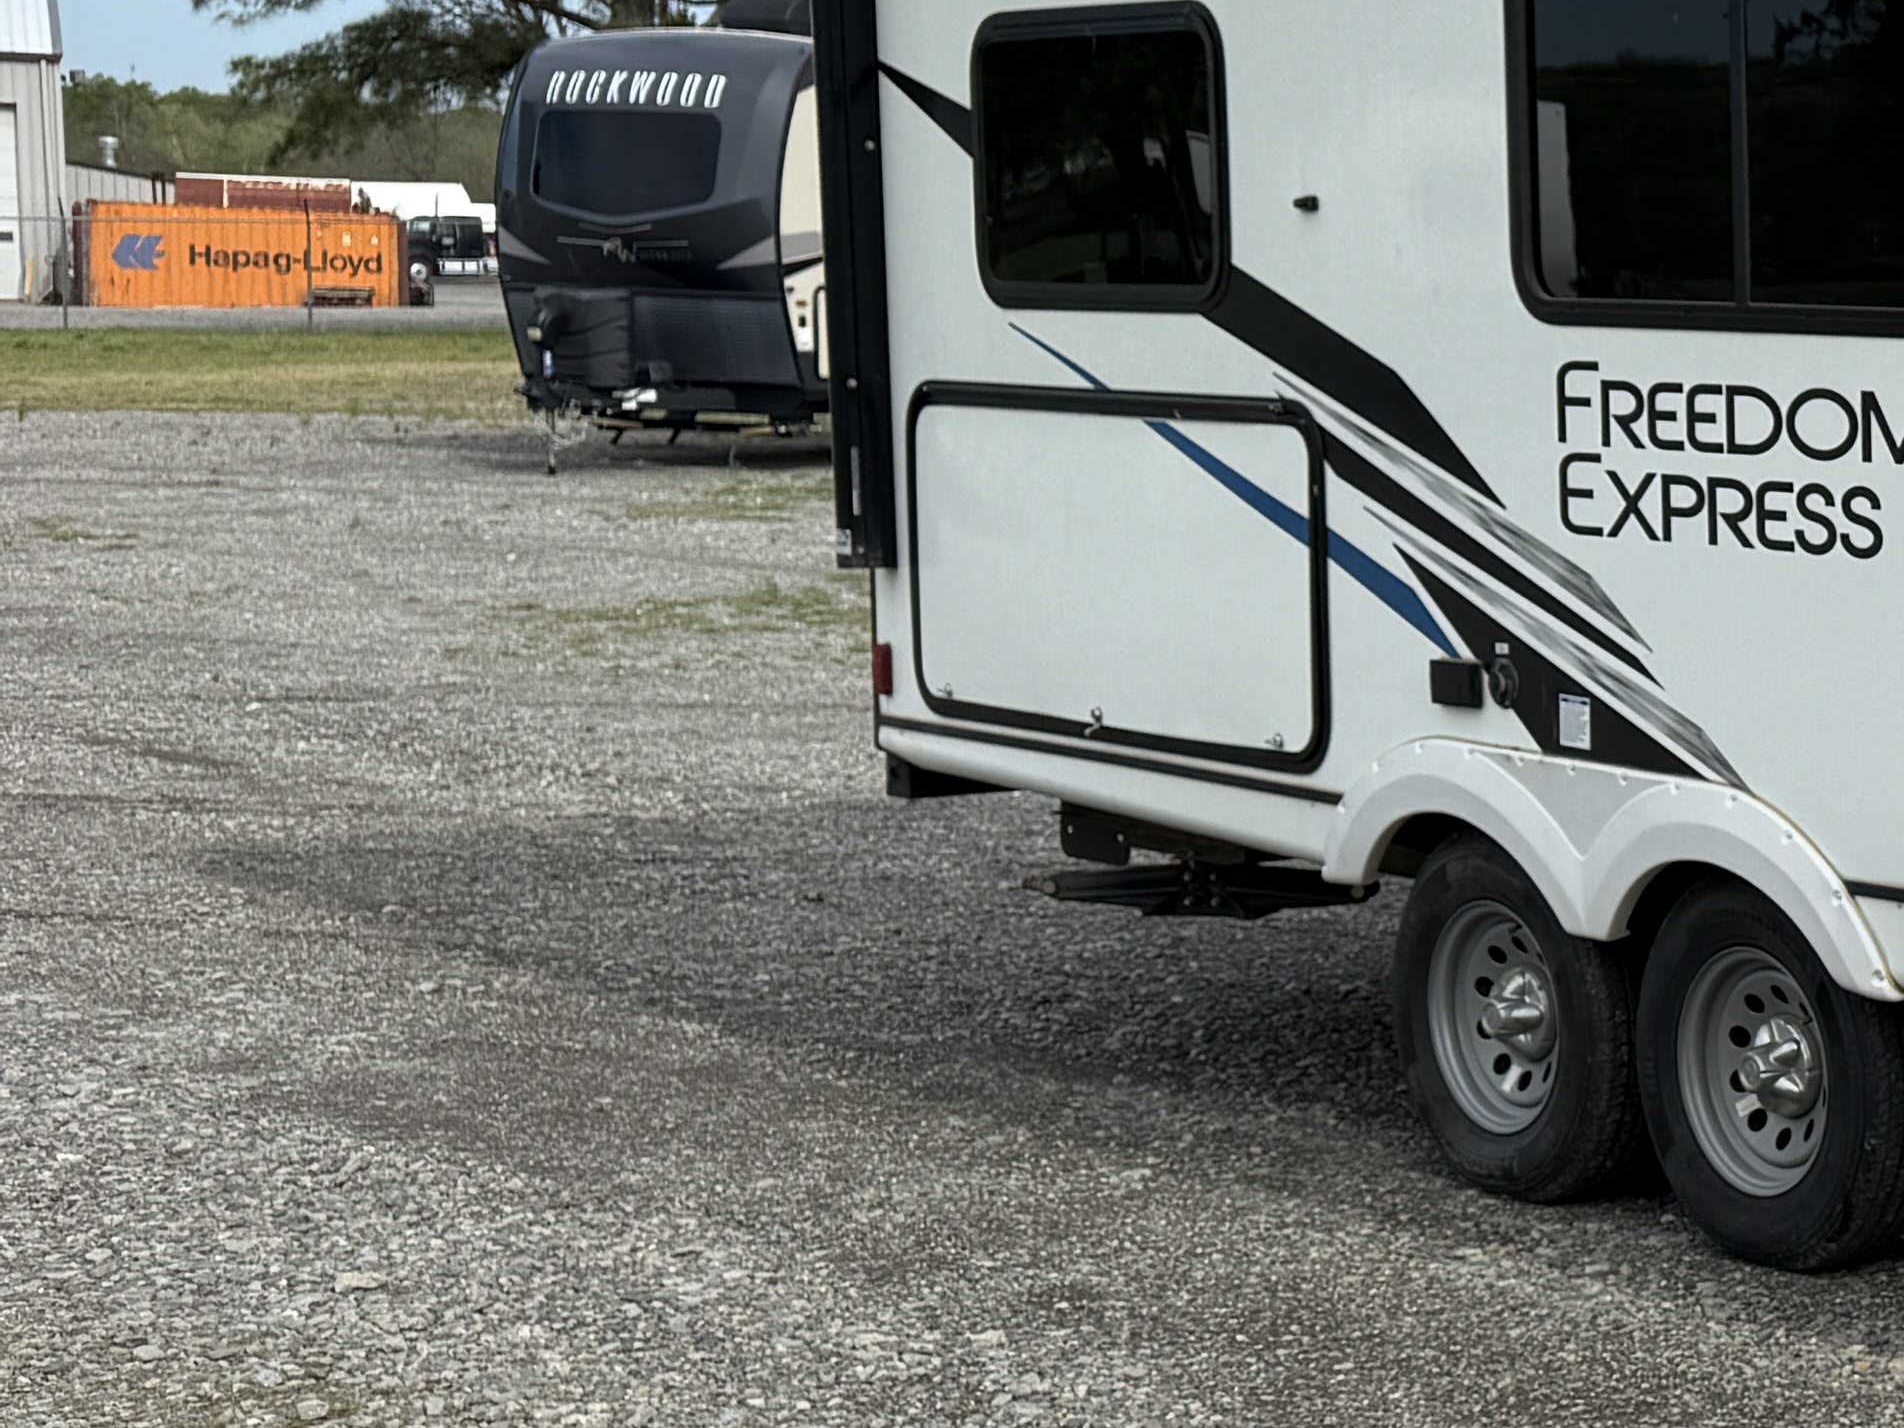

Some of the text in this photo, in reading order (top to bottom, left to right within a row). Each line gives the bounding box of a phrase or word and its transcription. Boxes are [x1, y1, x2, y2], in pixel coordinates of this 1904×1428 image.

[545, 69, 727, 109] ROCKWOOD
[188, 243, 383, 278] Hapag-Lloyd
[1558, 452, 1884, 560] EXPRESS
